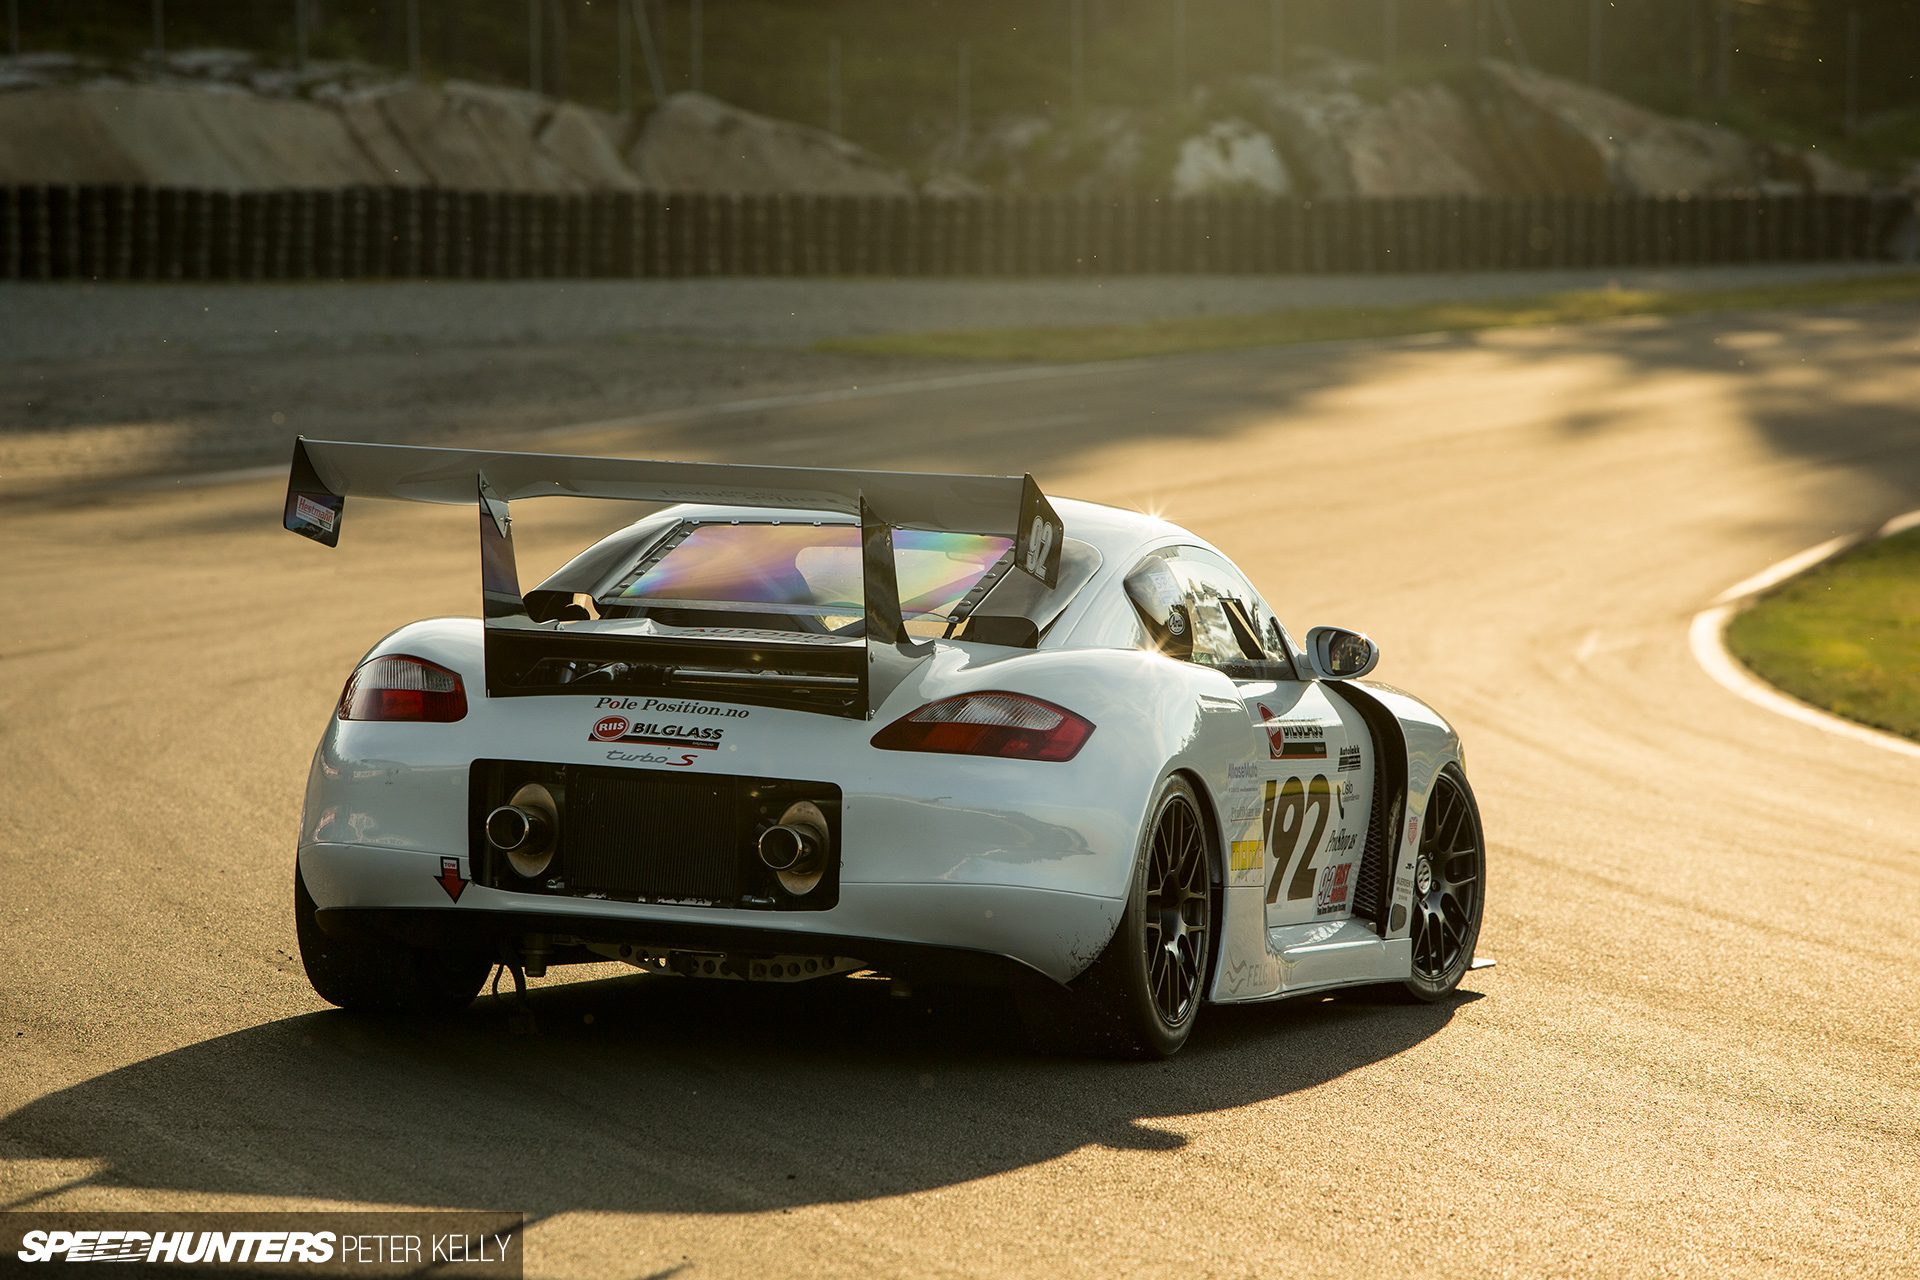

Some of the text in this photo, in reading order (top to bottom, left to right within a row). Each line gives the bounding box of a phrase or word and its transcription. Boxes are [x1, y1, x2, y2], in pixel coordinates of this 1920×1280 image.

[299, 498, 333, 522] Hestmann
[1027, 516, 1053, 580] 92
[594, 696, 750, 719] Pole Position.no
[599, 721, 624, 732] RIIS
[631, 723, 724, 740] BILGLASS
[606, 750, 698, 766] turbo S
